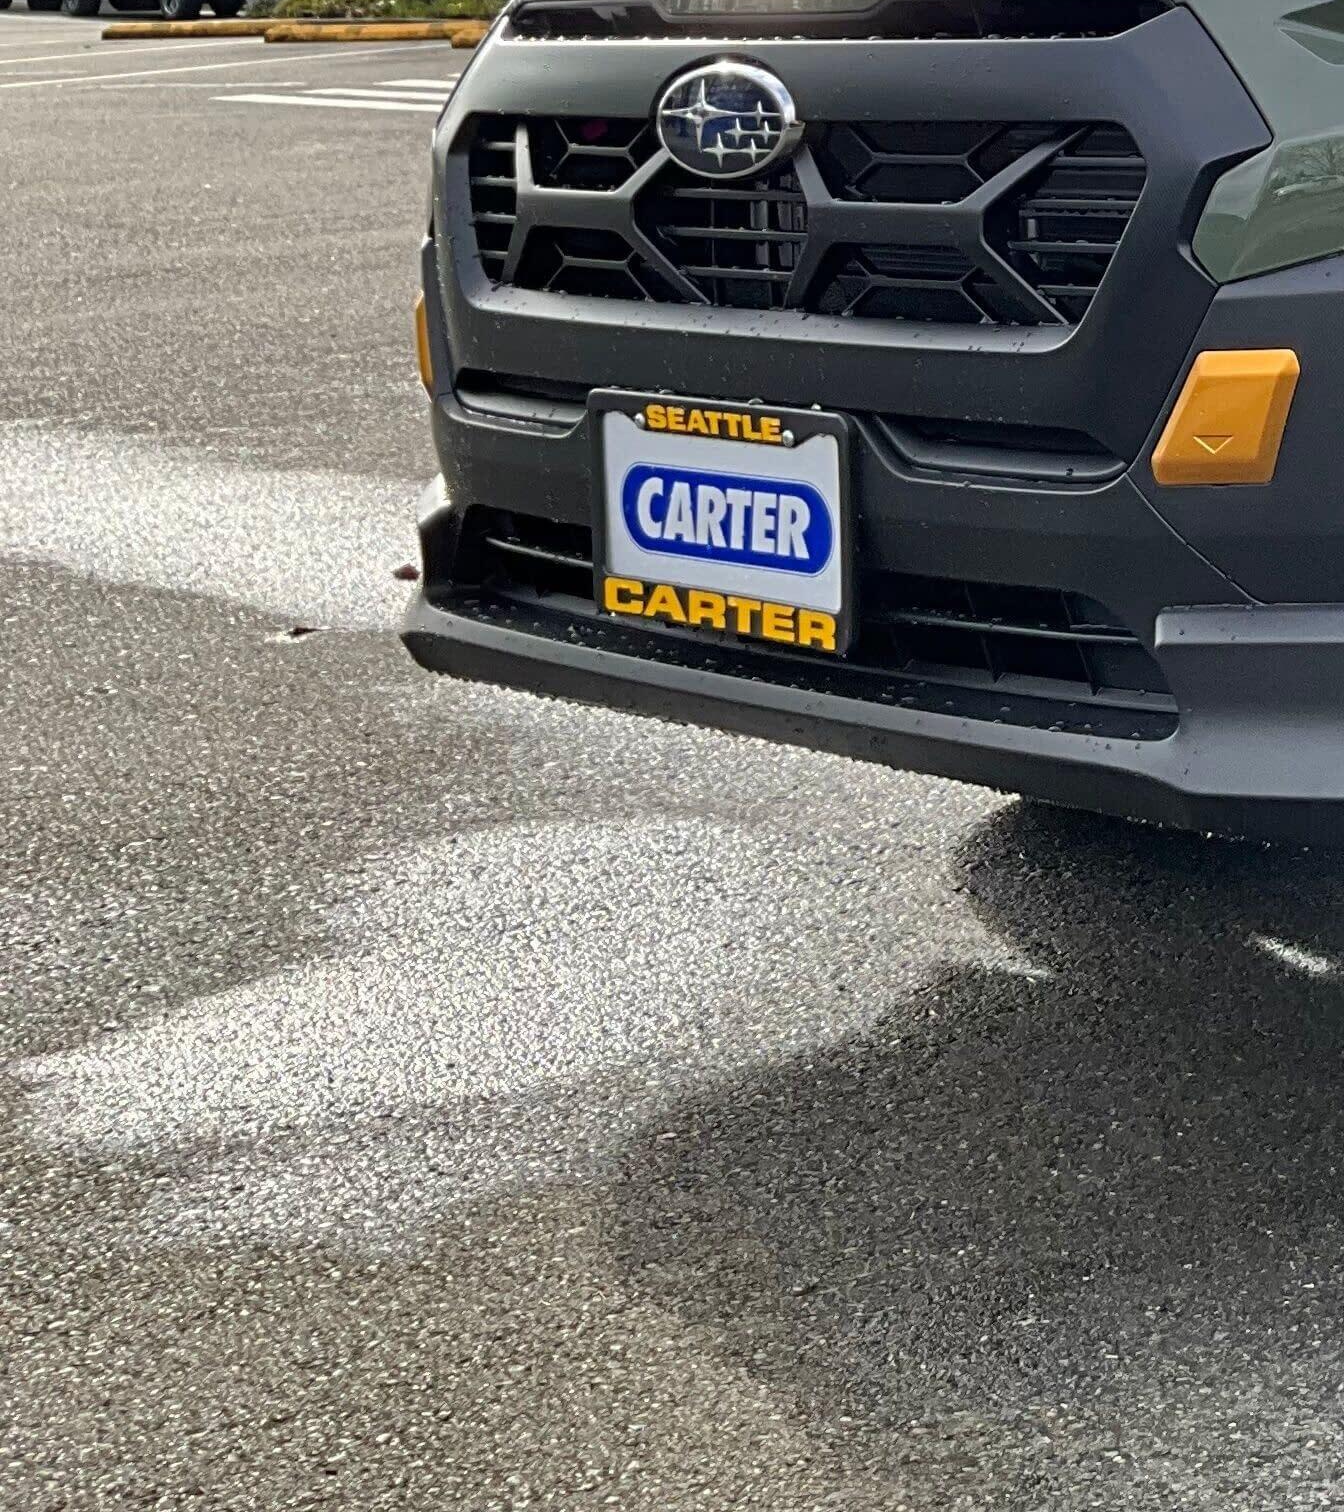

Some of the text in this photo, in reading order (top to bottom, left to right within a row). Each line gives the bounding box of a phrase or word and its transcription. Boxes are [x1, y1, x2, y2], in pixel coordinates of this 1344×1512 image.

[643, 404, 783, 443] SEATTLE
[636, 476, 811, 560] CARTER
[603, 576, 838, 652] CARTER
